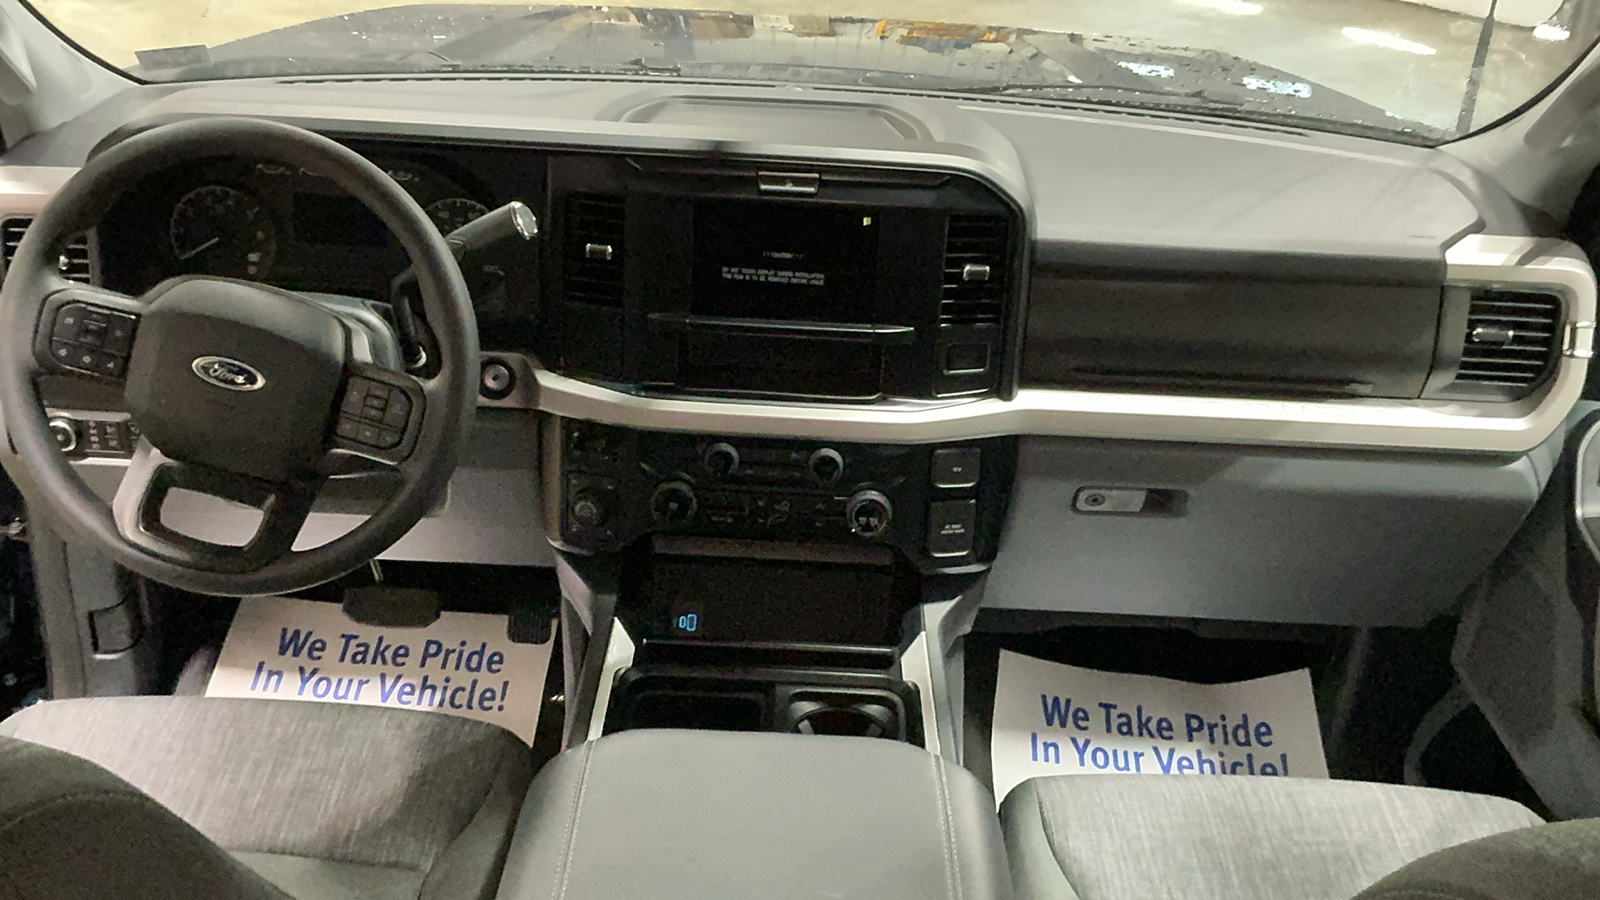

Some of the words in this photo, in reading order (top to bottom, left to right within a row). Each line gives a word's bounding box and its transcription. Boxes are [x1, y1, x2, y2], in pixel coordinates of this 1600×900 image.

[206, 362, 247, 384] Ford
[278, 627, 327, 661] We
[338, 633, 410, 668] Take
[419, 639, 504, 673] Pride
[250, 661, 284, 693] In
[297, 666, 369, 700] Your
[379, 672, 509, 712] Vehicle!
[1040, 693, 1089, 731] We
[1098, 702, 1174, 740] Take
[1184, 713, 1273, 747] Pride
[1030, 732, 1060, 764] In
[1069, 736, 1144, 773] Your
